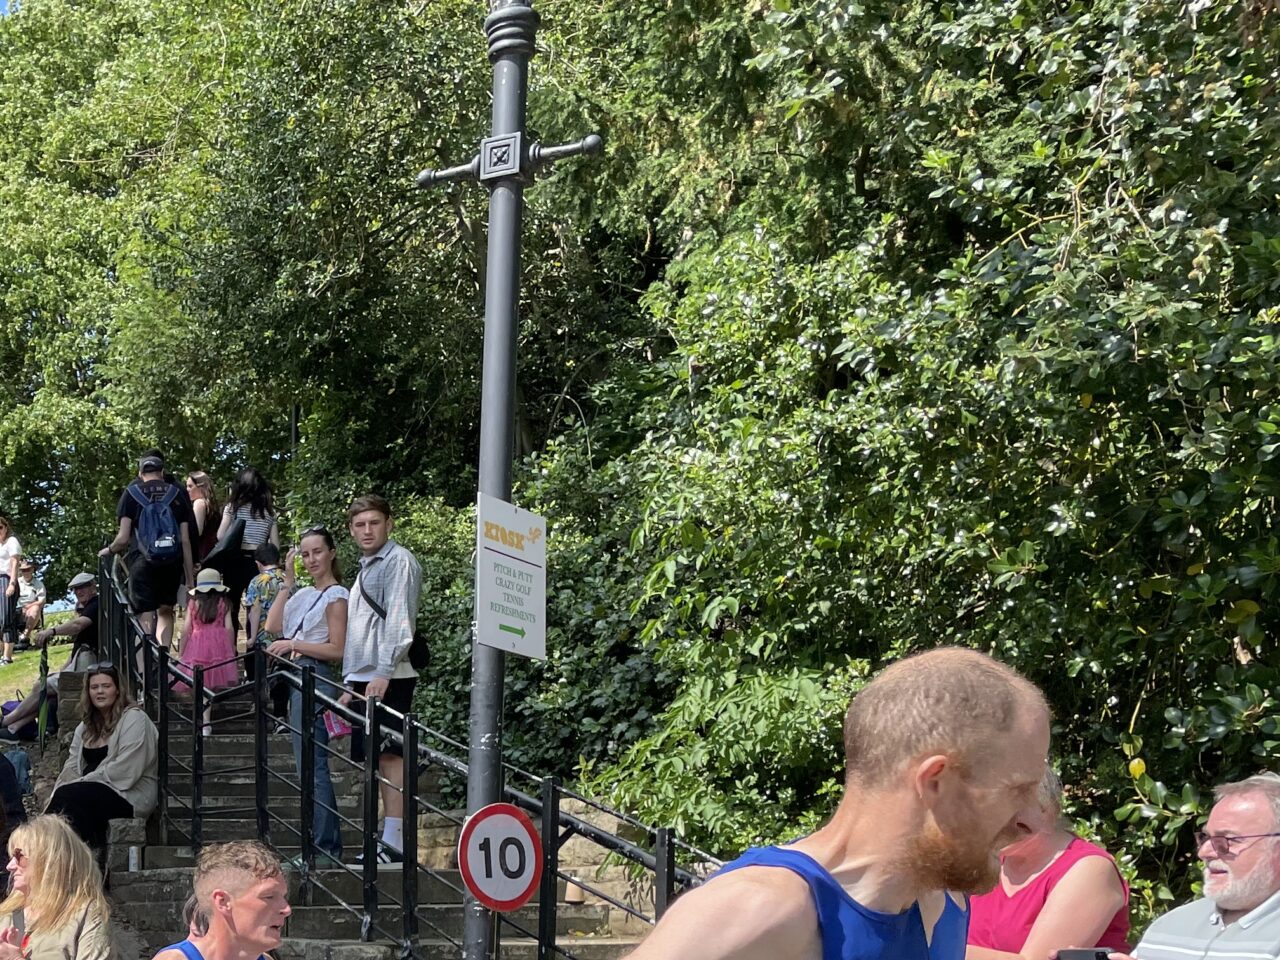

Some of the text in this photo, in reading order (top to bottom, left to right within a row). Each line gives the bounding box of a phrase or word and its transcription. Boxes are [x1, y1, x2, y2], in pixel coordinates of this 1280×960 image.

[484, 521, 525, 551] KIOSK
[493, 562, 512, 577] PITCH
[517, 570, 533, 584] PUTT
[495, 576, 531, 596] CRAZY GOLF
[503, 592, 524, 607] TENNIS
[490, 601, 536, 623] REFRESHMENTS
[478, 836, 527, 880] 10
